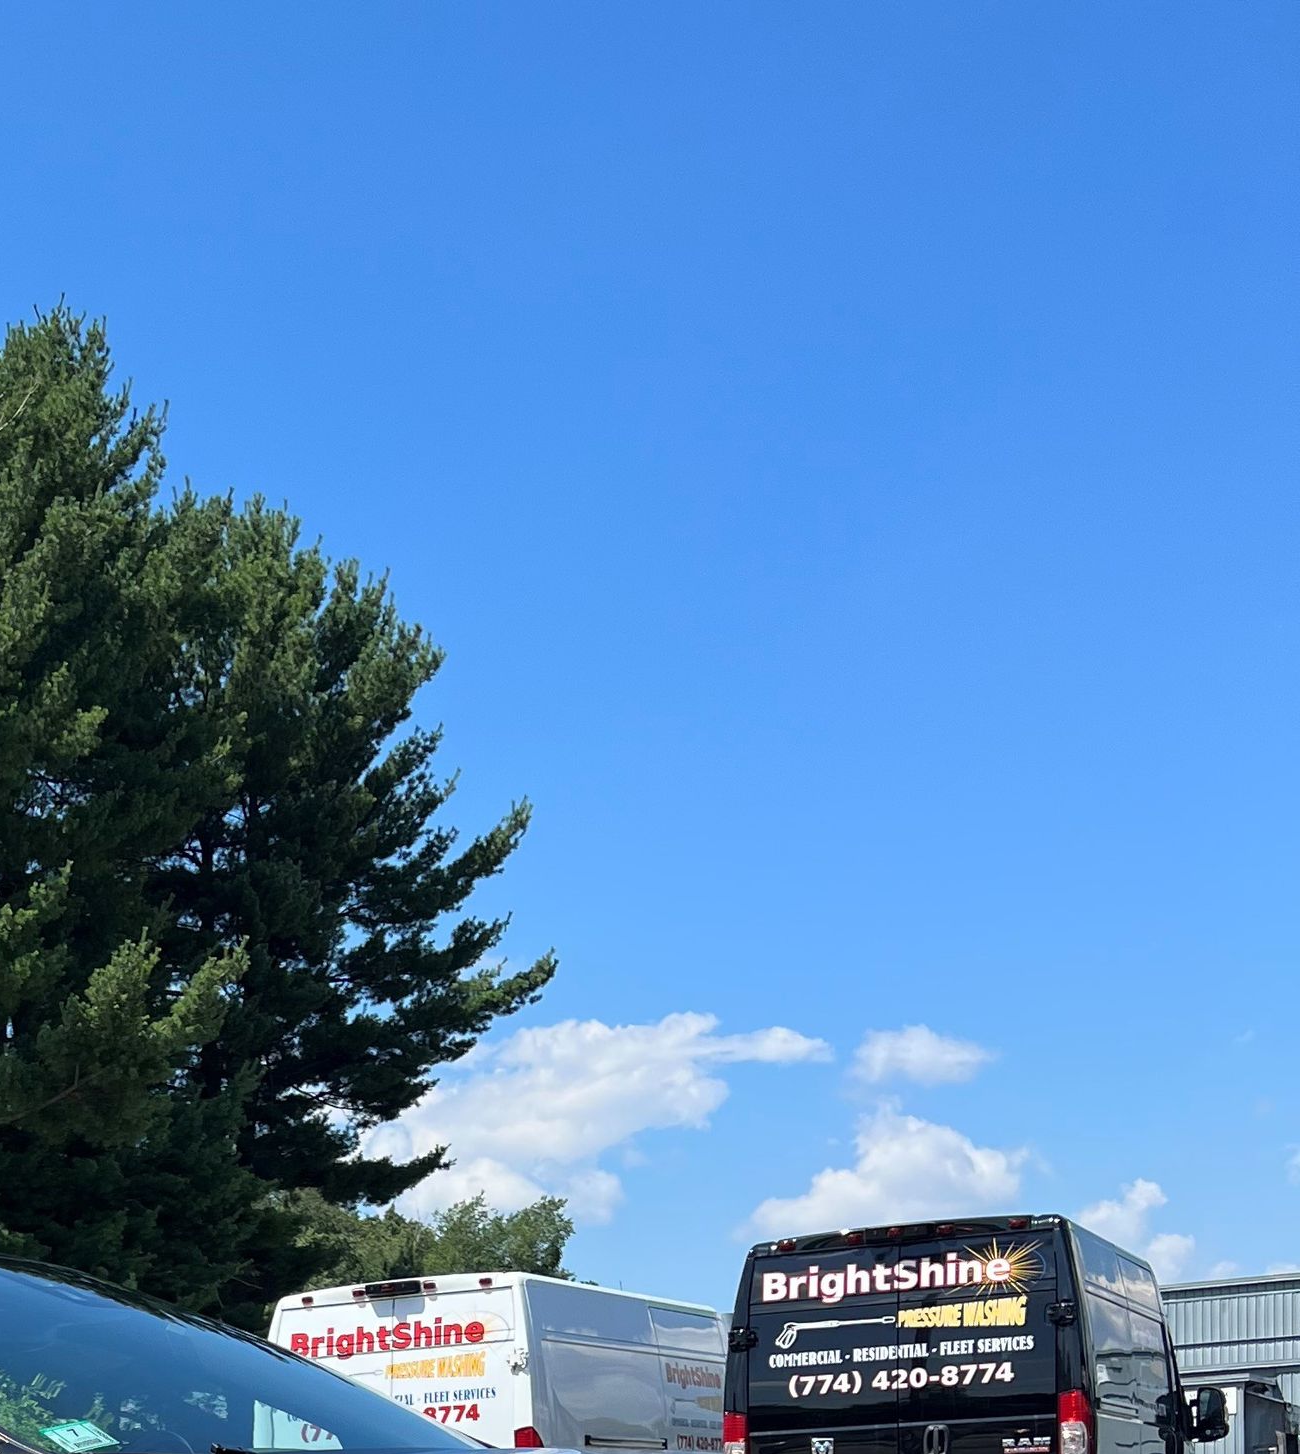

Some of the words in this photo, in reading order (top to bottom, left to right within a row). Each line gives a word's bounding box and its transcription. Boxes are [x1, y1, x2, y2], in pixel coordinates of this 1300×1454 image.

[762, 1252, 1012, 1303] BrightShine
[896, 1303, 962, 1328] PRESSURE
[963, 1296, 1028, 1328] WASHING
[290, 1317, 485, 1360] BrightShine
[768, 1350, 843, 1368] COMMERCIAL
[853, 1343, 929, 1363] RESIDENTIAL
[940, 1339, 974, 1356] FLEET
[977, 1335, 1035, 1352] SERVICES
[384, 1359, 436, 1380] PRESSURE
[436, 1350, 487, 1378] WASHING
[788, 1370, 862, 1398] (774)
[872, 1361, 1015, 1391] 420-8774
[424, 1391, 450, 1404] FLEET
[453, 1386, 497, 1401] SERVICES
[1001, 1436, 1052, 1447] RAM
